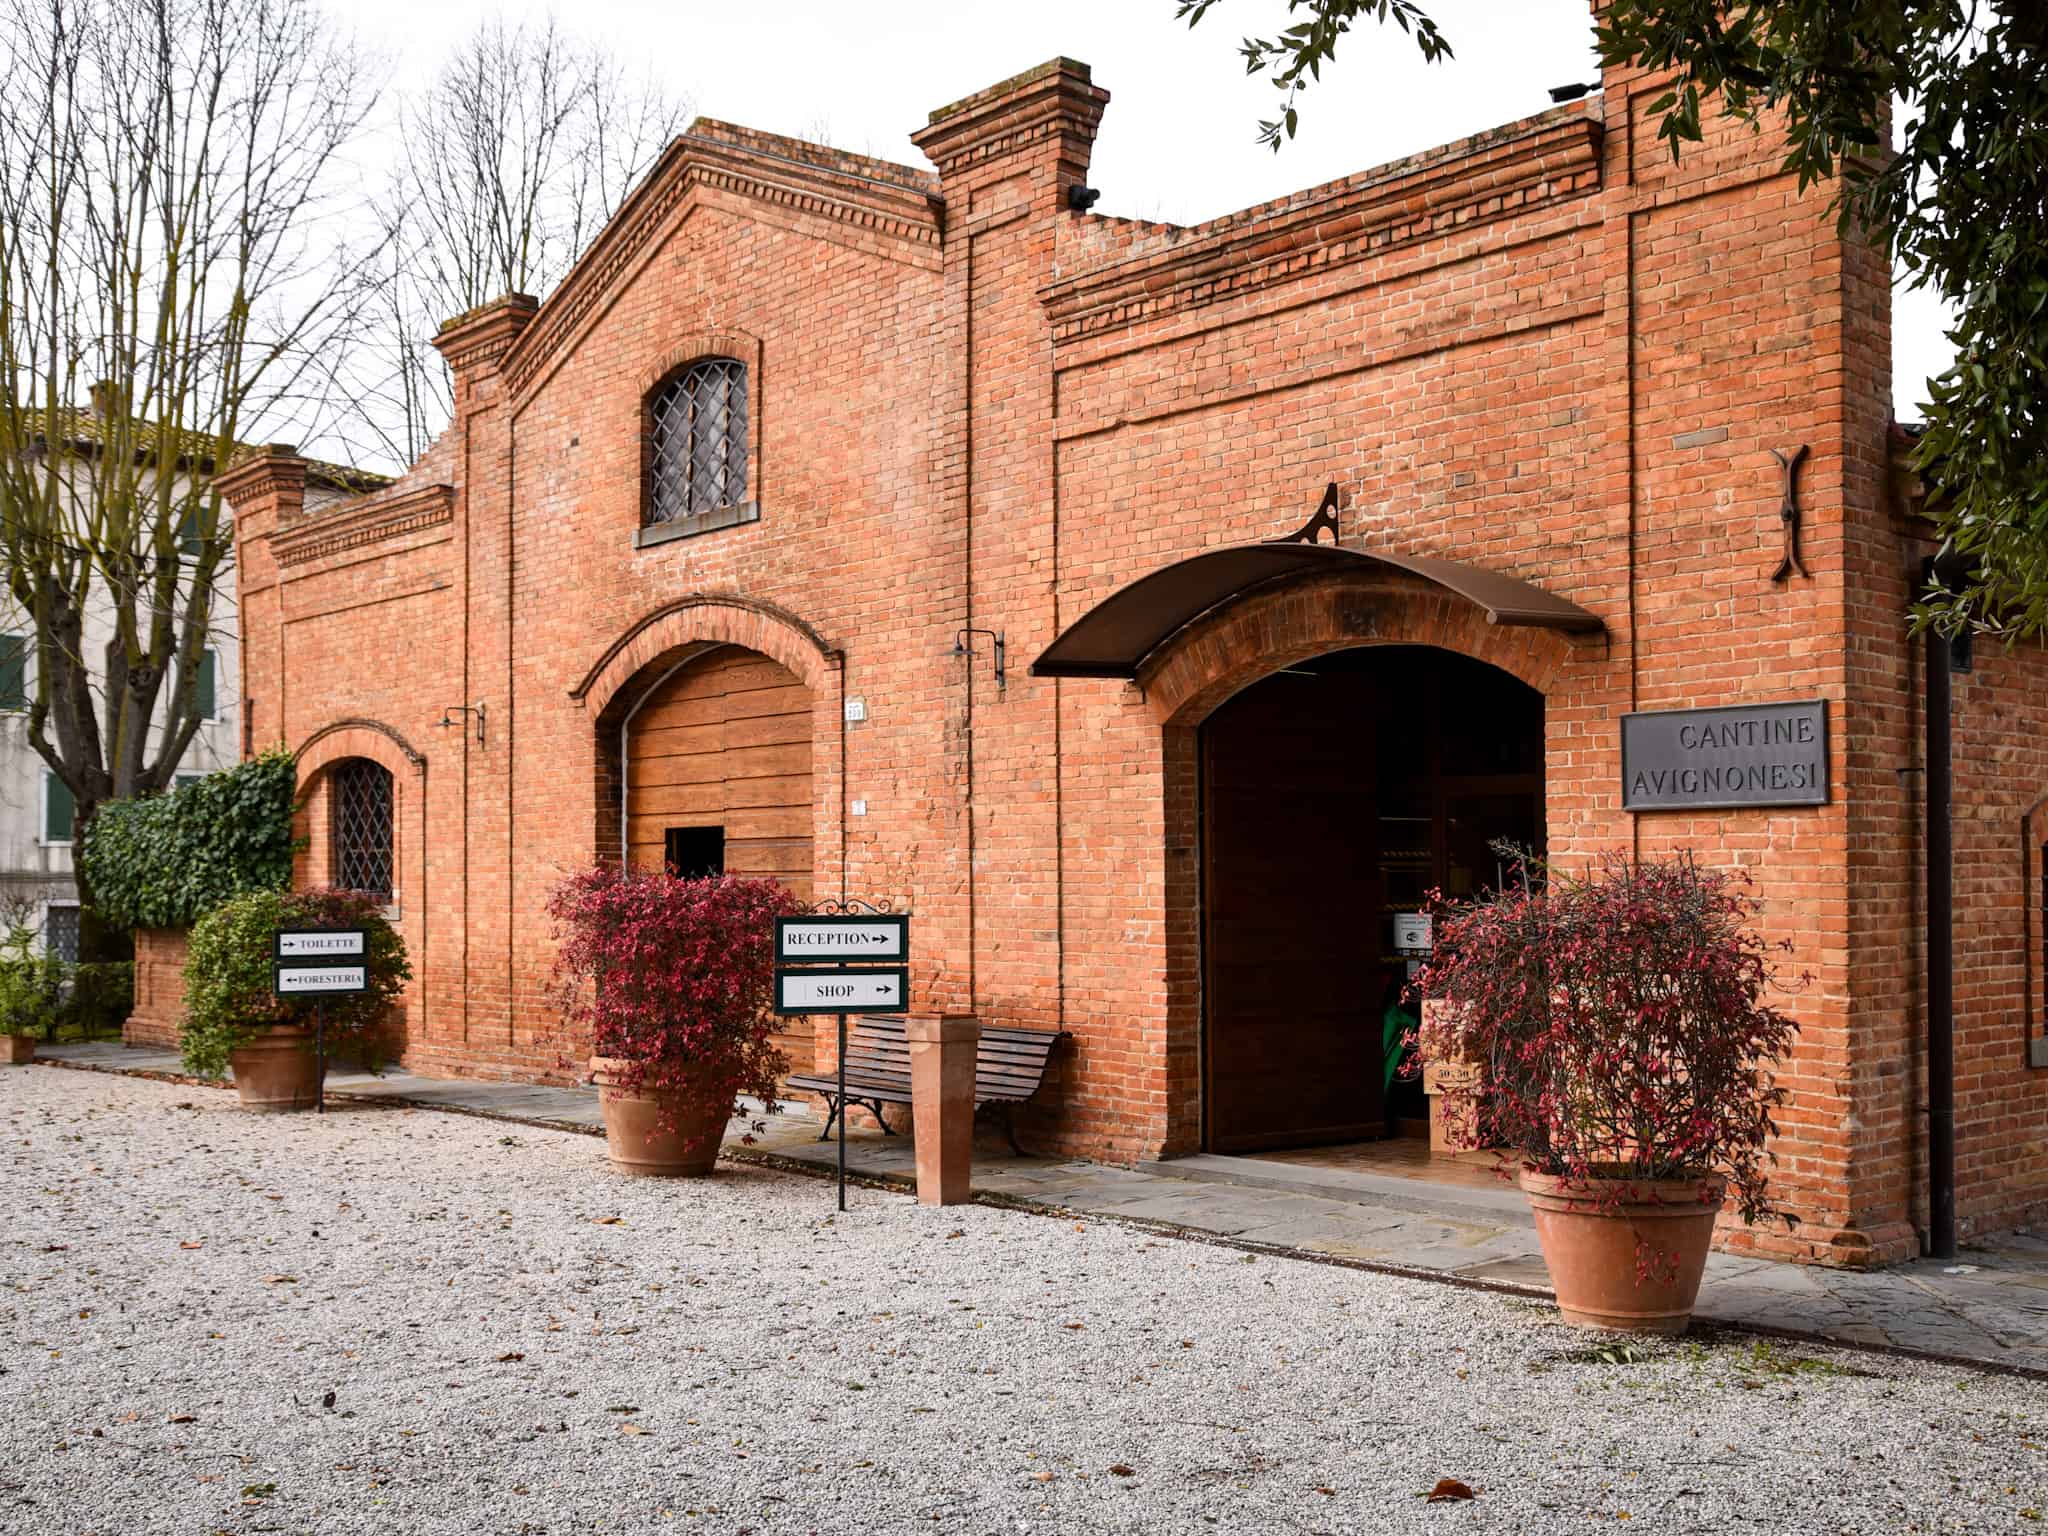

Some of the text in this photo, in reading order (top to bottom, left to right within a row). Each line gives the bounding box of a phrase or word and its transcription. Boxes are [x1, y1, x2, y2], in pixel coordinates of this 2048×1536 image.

[1679, 717, 1815, 749] CANTINE
[1632, 763, 1817, 796] AVIGNONESI
[301, 939, 355, 949] TOILETTE
[788, 932, 870, 945] RECEPTION
[298, 974, 362, 985] FORESTERIA
[816, 985, 855, 998] SHOP
